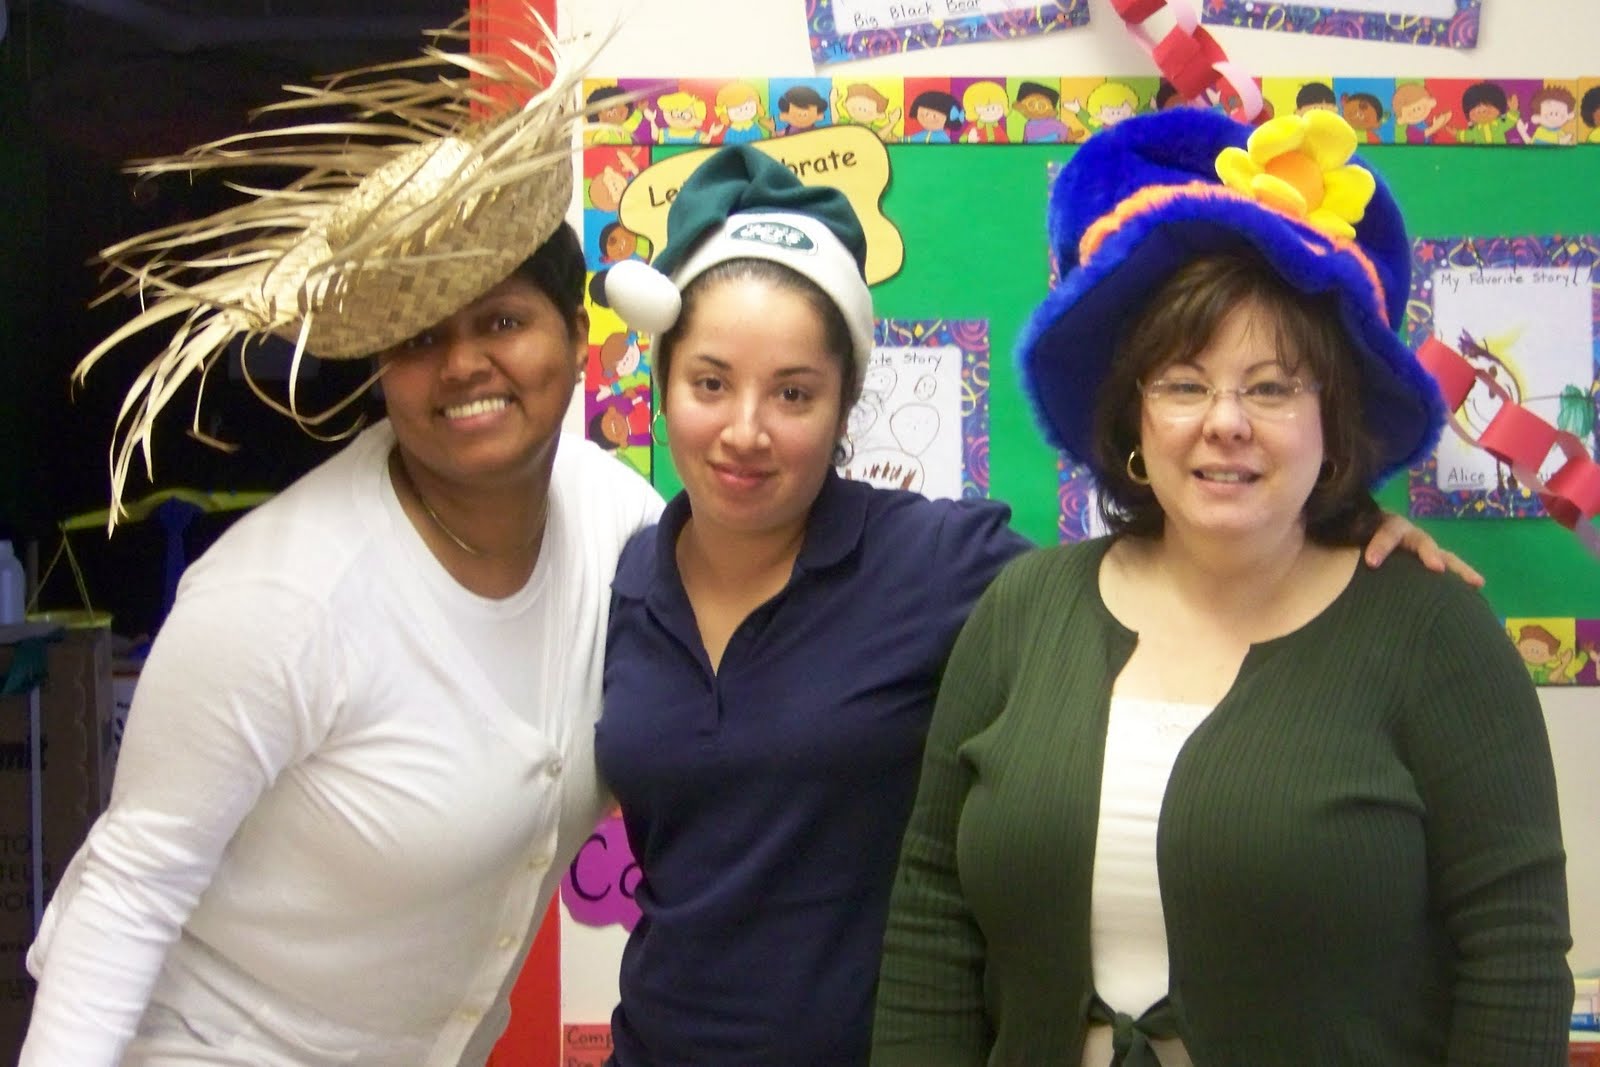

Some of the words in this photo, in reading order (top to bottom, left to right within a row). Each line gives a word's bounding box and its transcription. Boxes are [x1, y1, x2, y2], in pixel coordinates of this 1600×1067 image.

[851, 12, 879, 29] Big
[889, 2, 931, 19] Black
[945, 0, 979, 12] Bear
[1441, 272, 1460, 293] My
[1469, 272, 1524, 286] Favorite
[903, 351, 942, 373] Story
[1447, 467, 1485, 482] Alice
